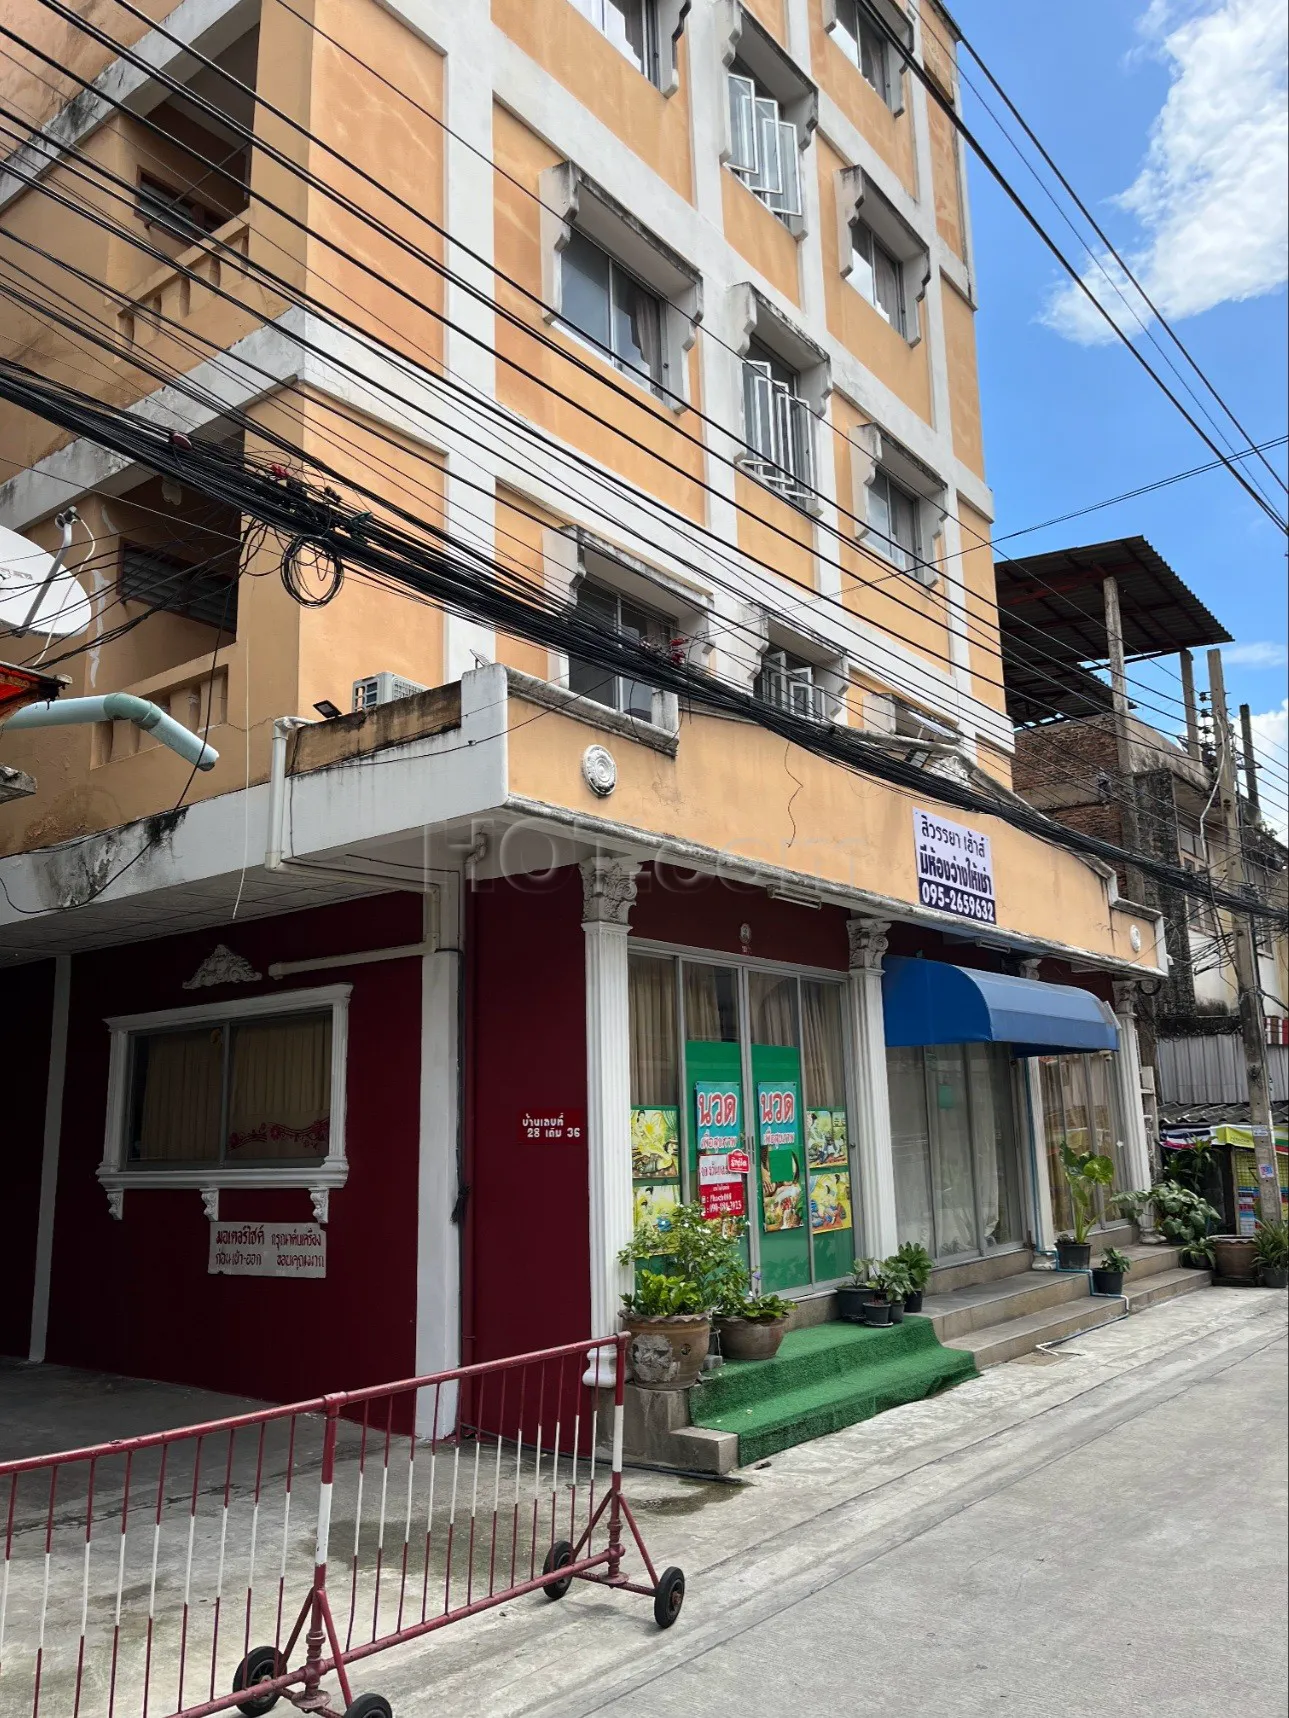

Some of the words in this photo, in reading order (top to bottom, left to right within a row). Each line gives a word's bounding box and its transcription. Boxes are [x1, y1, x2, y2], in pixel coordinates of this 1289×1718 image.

[919, 844, 992, 895] มีห้องว่างให้เช่า
[921, 882, 994, 921] 095-2659632
[522, 1112, 563, 1126] บ้านเลขที่
[698, 1092, 737, 1126] นวด
[760, 1091, 795, 1124] นวด
[527, 1127, 540, 1137] 28
[545, 1127, 562, 1137] เดิม
[567, 1127, 580, 1137] 36
